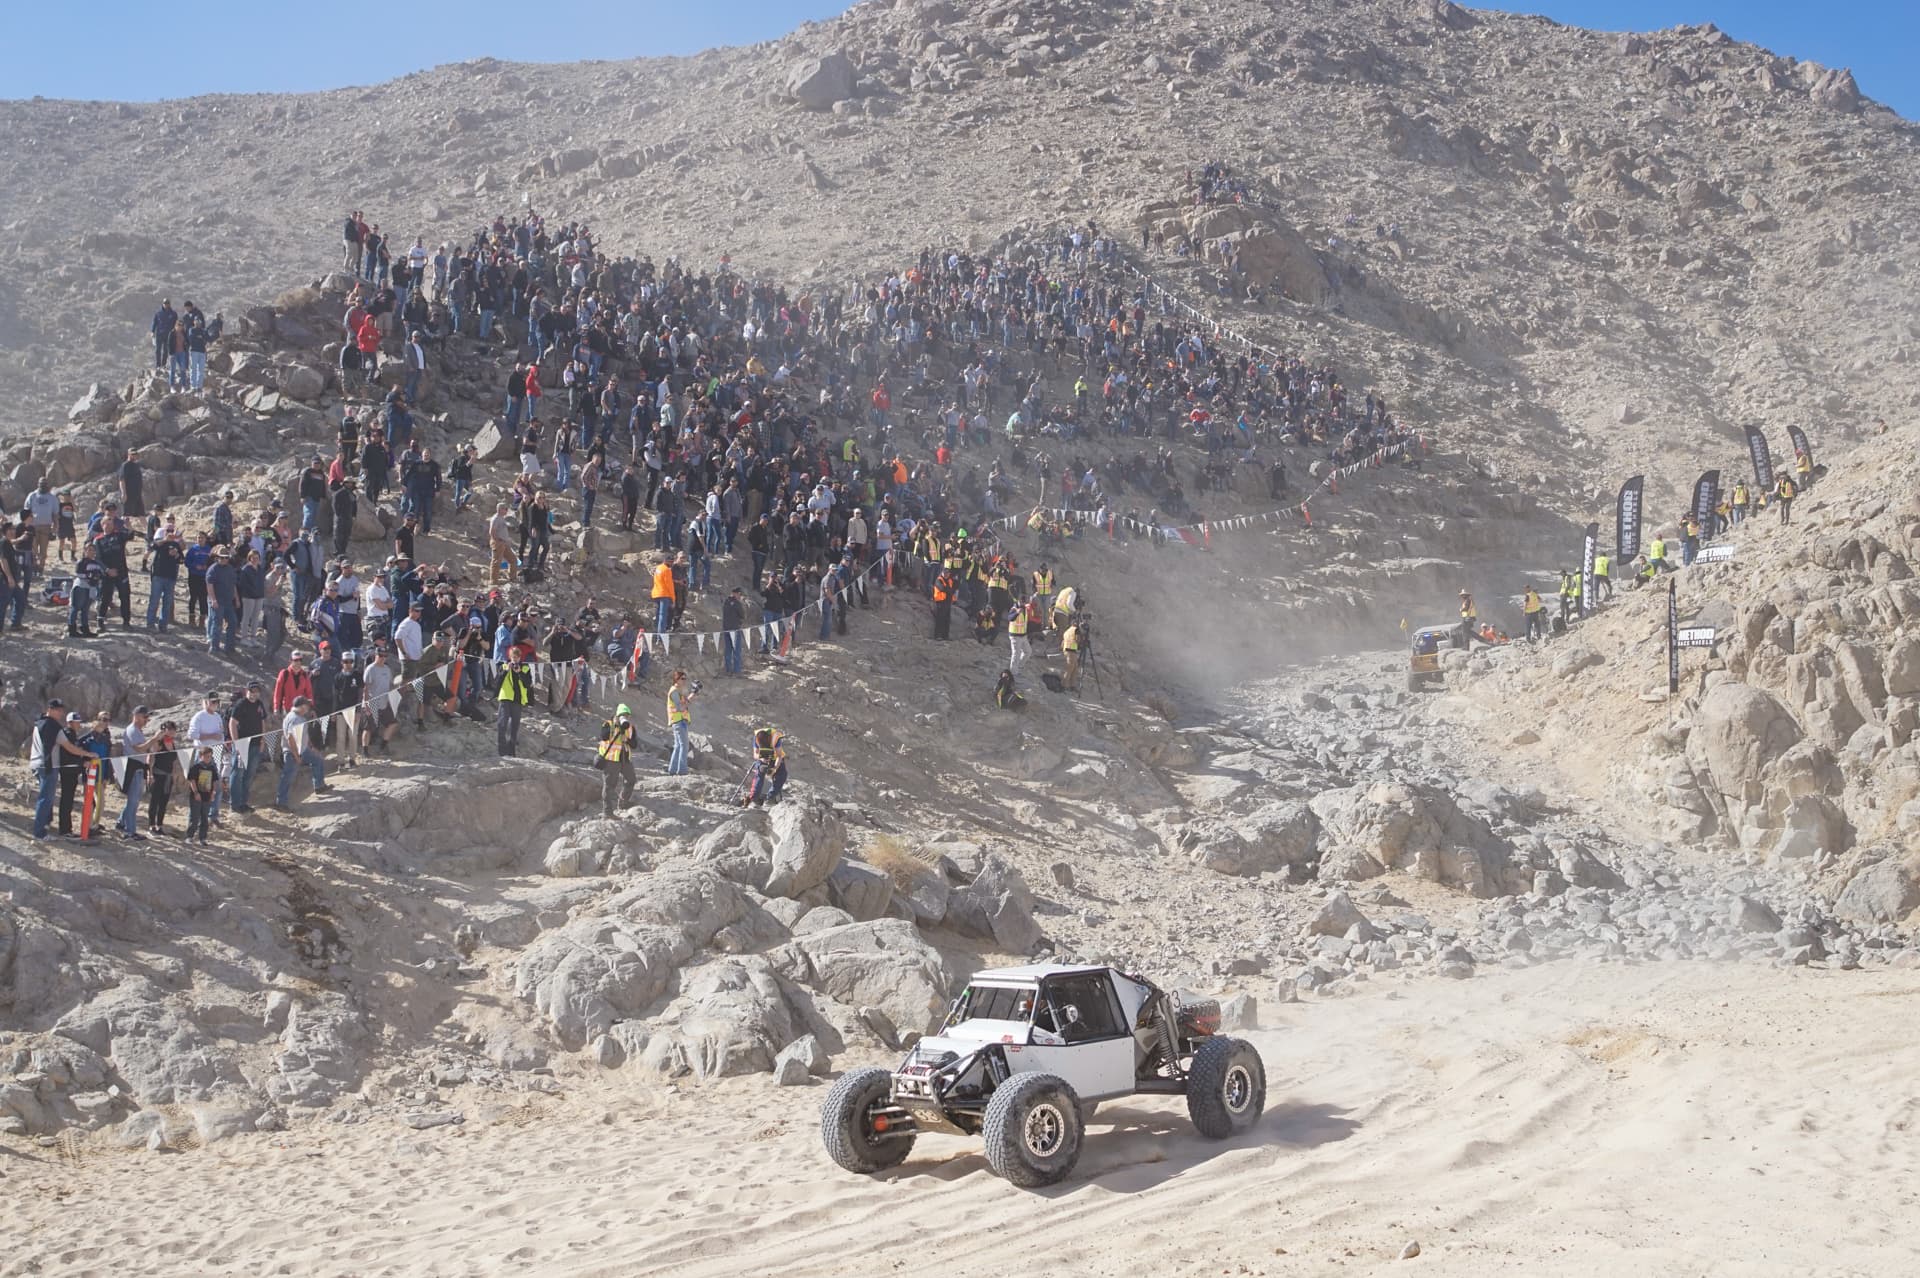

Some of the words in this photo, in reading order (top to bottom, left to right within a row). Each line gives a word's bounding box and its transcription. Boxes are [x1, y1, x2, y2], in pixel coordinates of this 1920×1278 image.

[1623, 490, 1633, 555] METHOD
[1697, 546, 1734, 559] METHOD
[1679, 628, 1715, 641] METHOD
